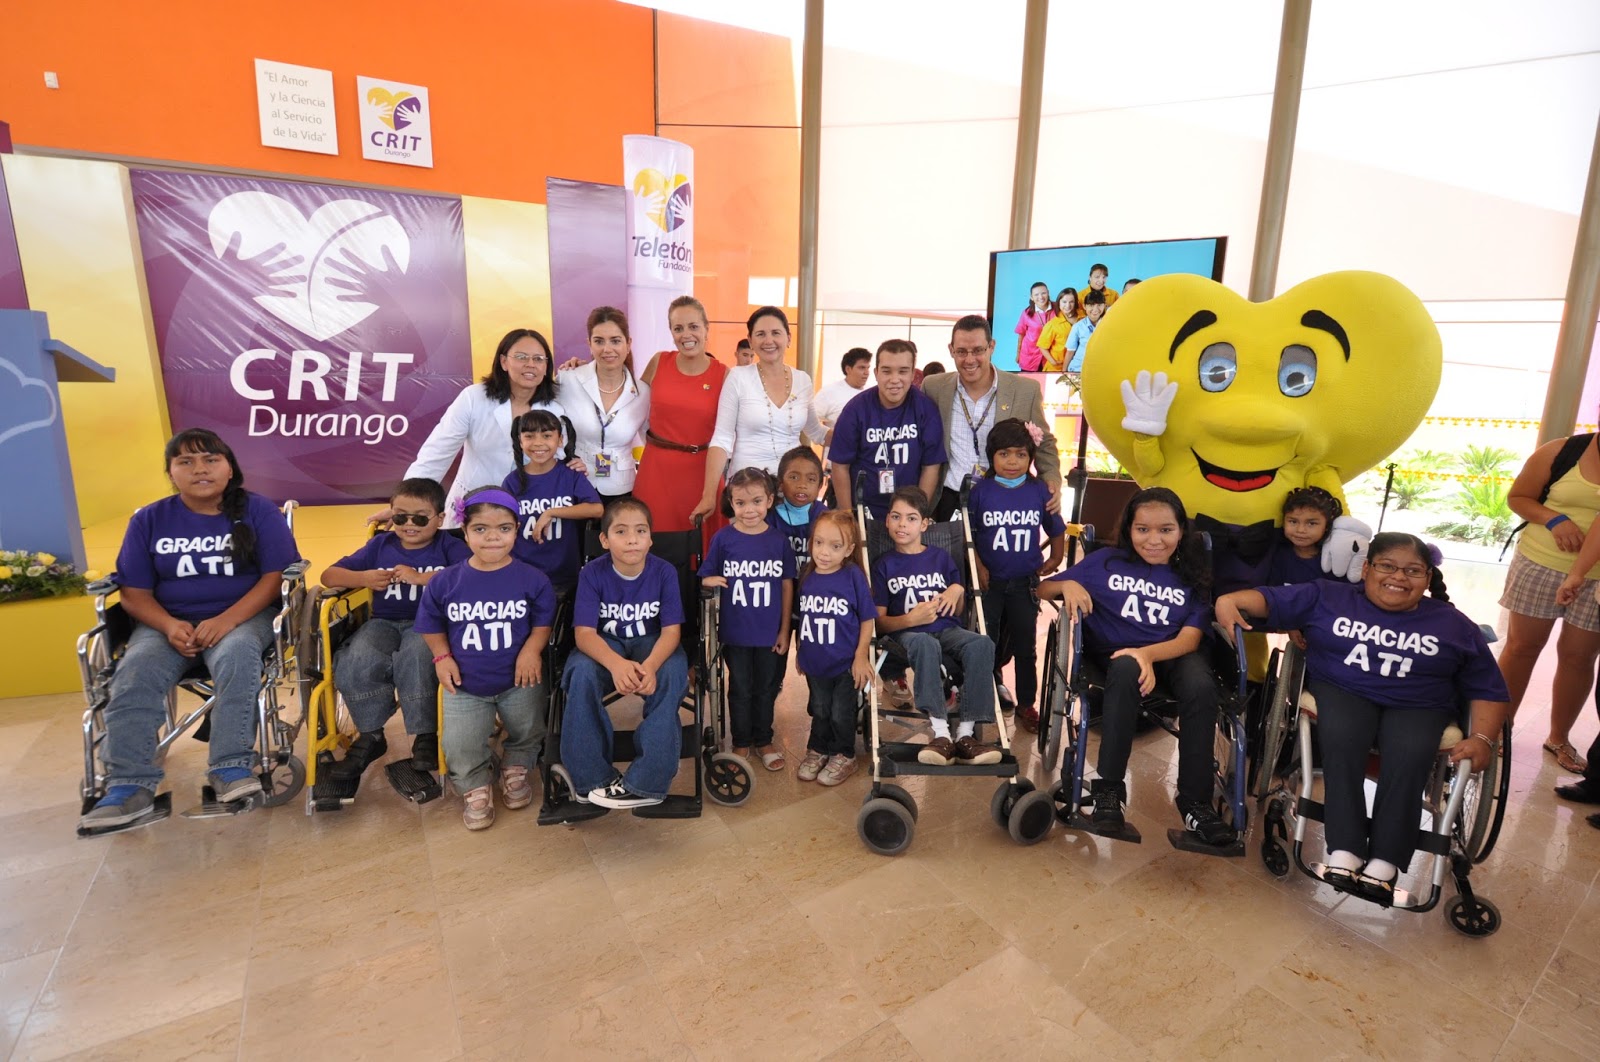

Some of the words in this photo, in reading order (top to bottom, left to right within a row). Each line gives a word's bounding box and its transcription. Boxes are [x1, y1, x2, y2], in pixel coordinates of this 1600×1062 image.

[281, 74, 308, 87] Amor
[270, 92, 276, 102] y
[279, 91, 288, 102] la
[291, 94, 326, 108] Ciencia
[272, 109, 280, 119] al
[284, 110, 322, 125] Servicio
[273, 127, 285, 137] de
[289, 129, 298, 139] la
[371, 131, 421, 152] CRIT
[384, 149, 411, 158] Durango
[632, 236, 692, 263] Teletón
[229, 348, 414, 402] CRIT
[248, 405, 409, 445] Durango
[866, 423, 918, 443] GRACIAS
[874, 442, 890, 465] A
[891, 443, 909, 465] TI
[518, 495, 573, 515] RACIAS
[982, 509, 1040, 527] GRACIAS
[155, 533, 234, 555] GRACIA
[992, 527, 1010, 552] A
[1011, 529, 1031, 552] TI
[176, 554, 200, 578] A
[201, 556, 234, 577] TI
[723, 560, 783, 578] GRACIAS
[732, 579, 748, 607] A
[749, 581, 771, 608] TI
[904, 587, 918, 614] A
[1107, 574, 1186, 607] GRACIAS
[447, 600, 528, 622] GRACIAS
[1121, 594, 1143, 623] A
[1143, 600, 1170, 626] TI
[461, 623, 483, 651] A
[484, 622, 513, 651] TI
[800, 614, 815, 643] A
[814, 618, 836, 645] TI
[1332, 616, 1440, 656] GRACIAS
[1343, 643, 1371, 672] A
[1377, 651, 1413, 678] TI
